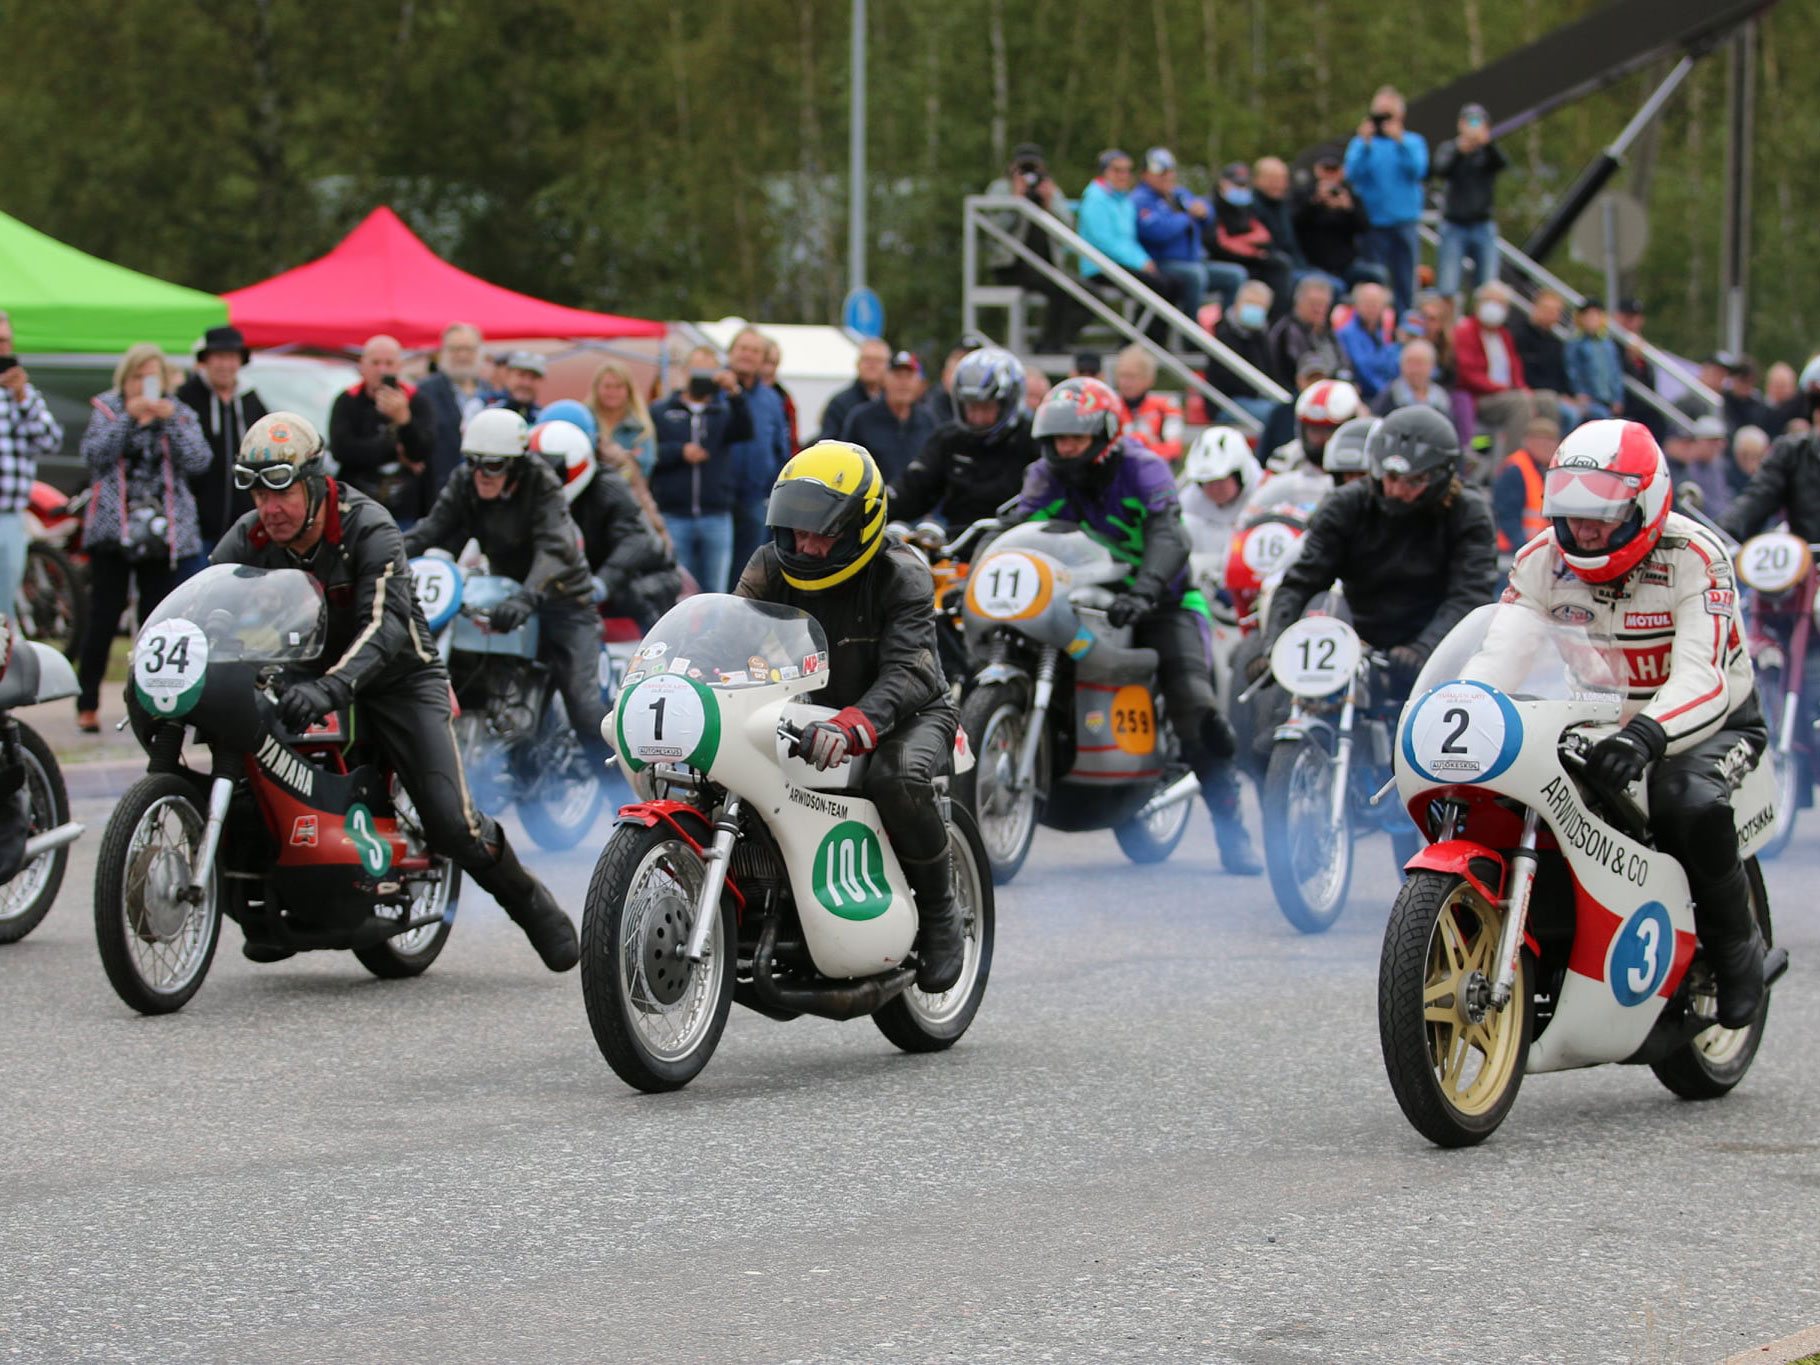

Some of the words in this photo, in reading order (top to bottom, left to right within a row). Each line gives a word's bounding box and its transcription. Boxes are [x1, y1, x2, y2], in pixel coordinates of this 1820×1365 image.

[1258, 535, 1286, 559] 16
[1755, 545, 1790, 571] 20
[989, 568, 1020, 598] 11
[1626, 615, 1670, 628] MOTUL
[145, 636, 190, 673] 34
[1297, 638, 1336, 670] 12
[649, 697, 666, 741] 1
[1115, 709, 1149, 734] 259
[1441, 708, 1470, 754] 2
[256, 734, 313, 797] YAMAHA
[788, 787, 848, 819] ARWIDSON-TEAM
[1540, 776, 1614, 867] ARWIDSON
[1611, 847, 1625, 876] &
[1627, 854, 1648, 887] CO
[826, 838, 883, 907] 101
[1627, 917, 1660, 994] 3
